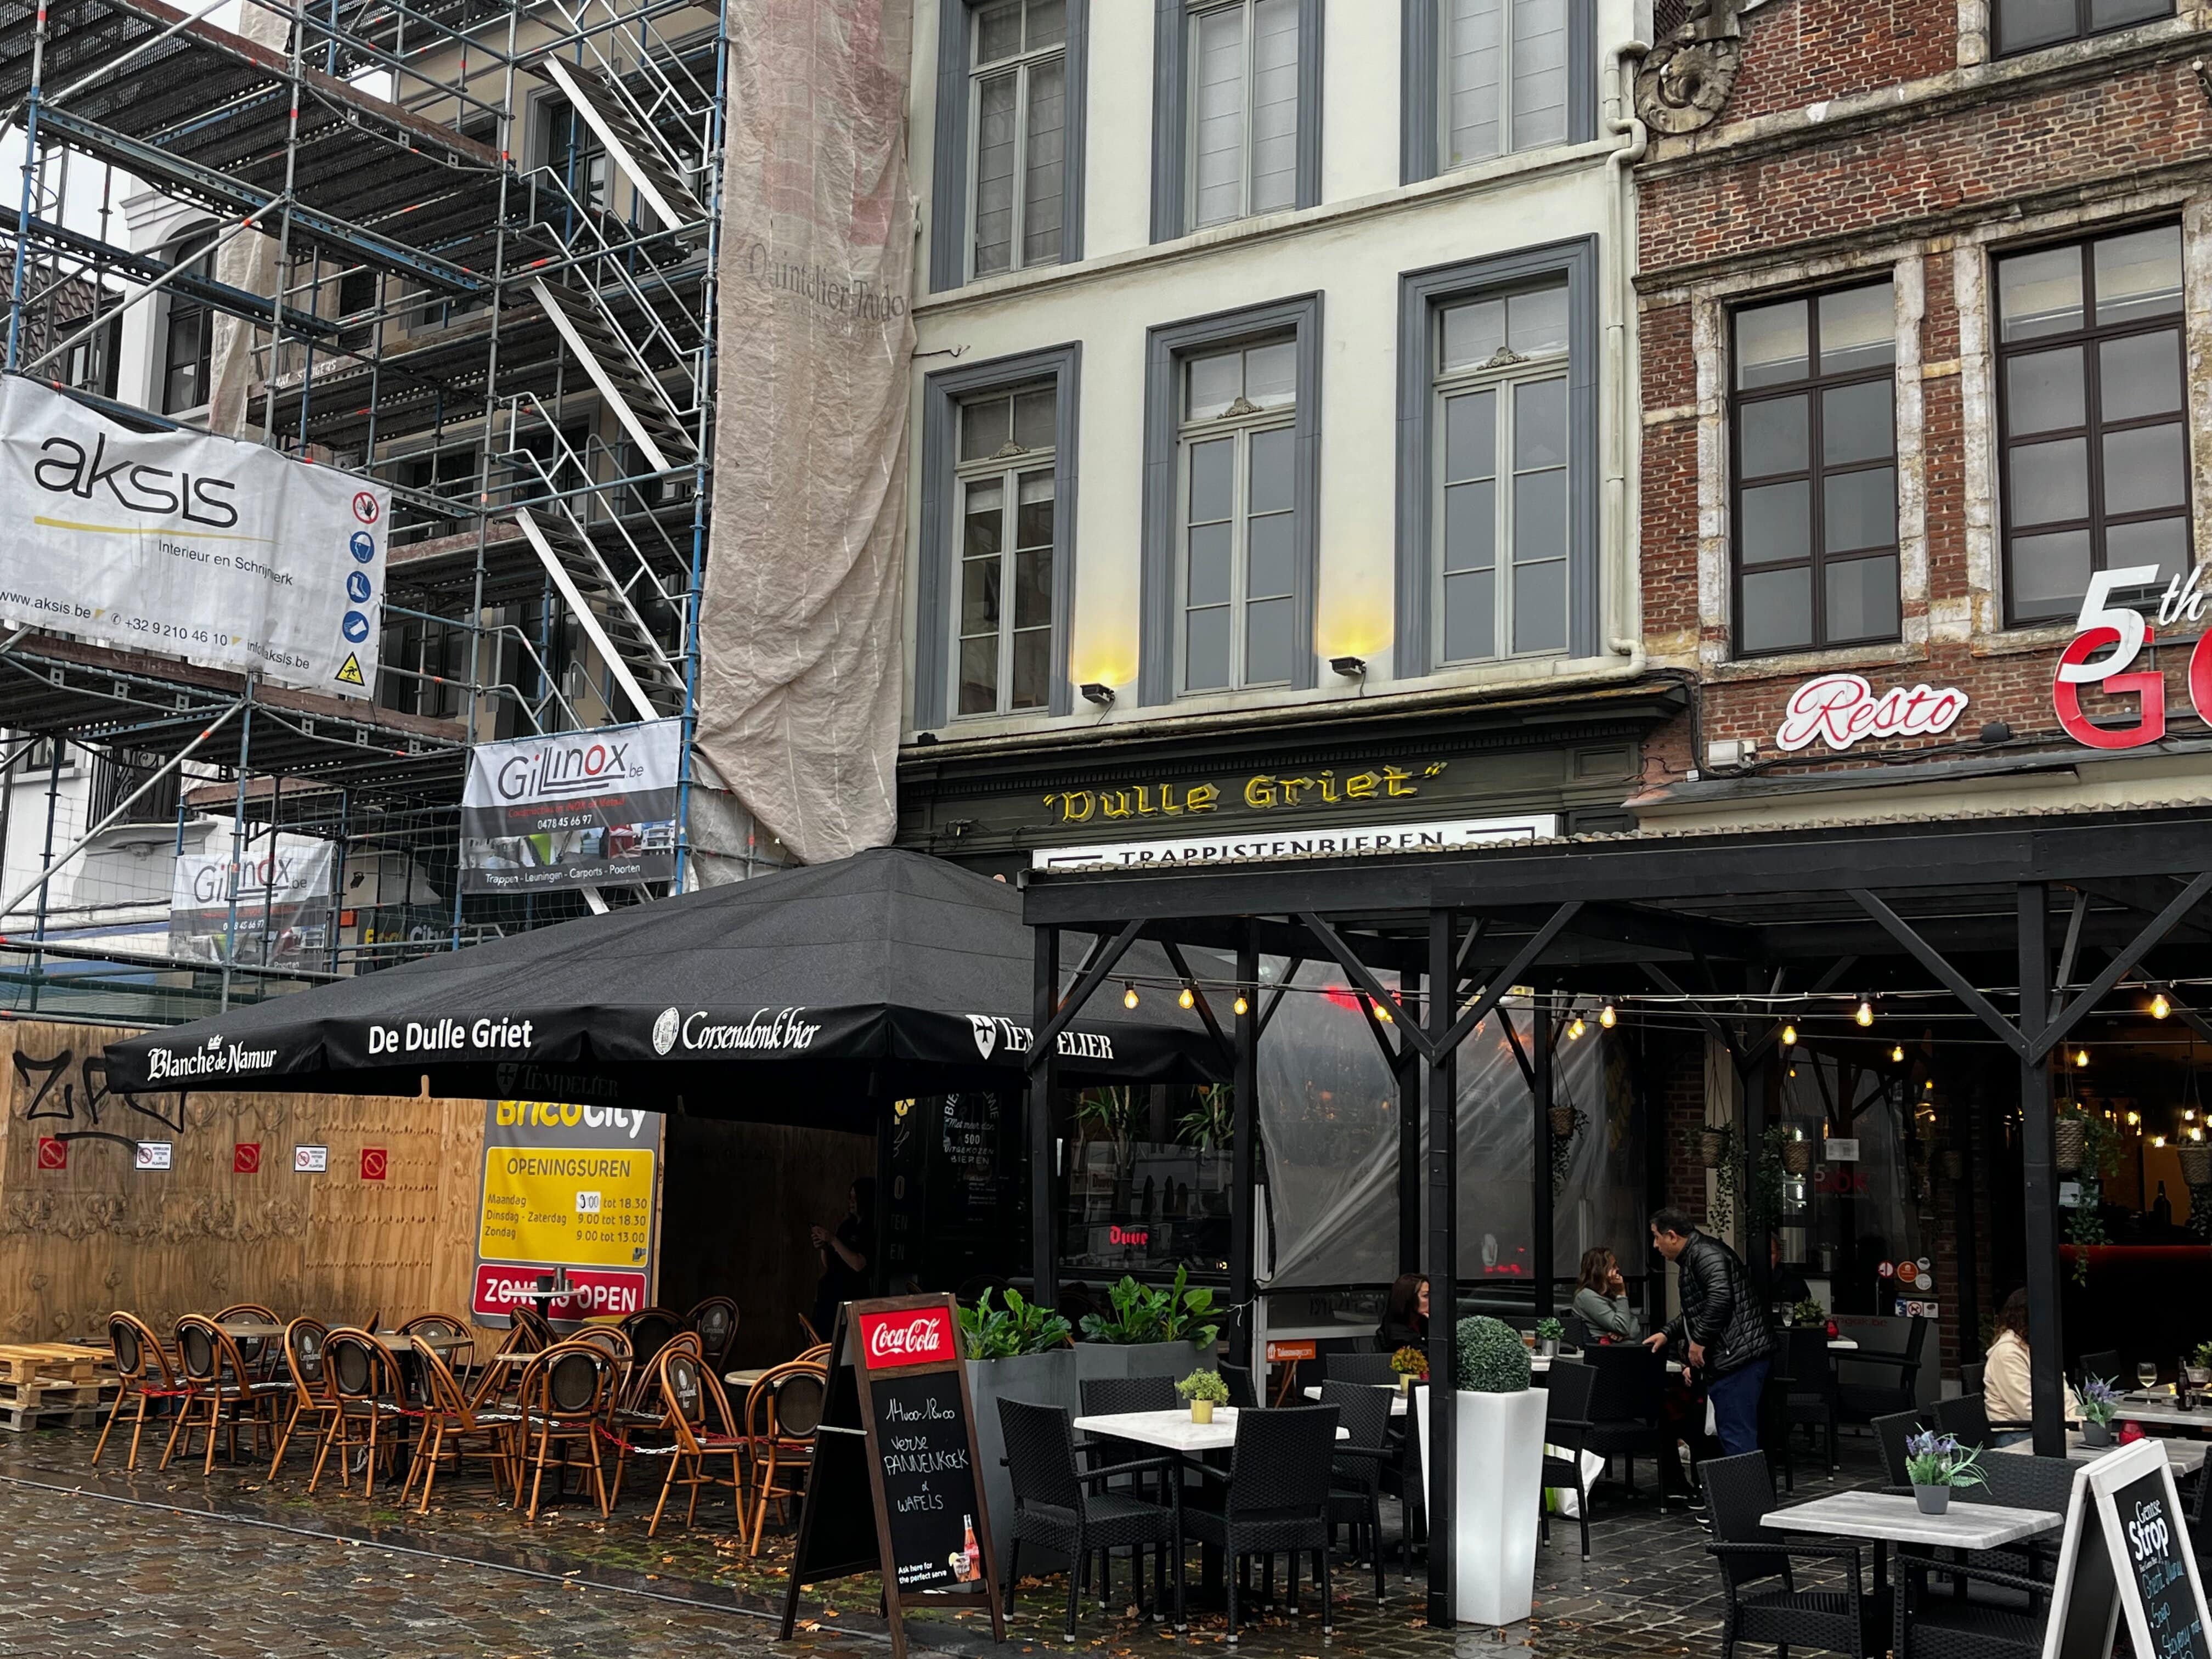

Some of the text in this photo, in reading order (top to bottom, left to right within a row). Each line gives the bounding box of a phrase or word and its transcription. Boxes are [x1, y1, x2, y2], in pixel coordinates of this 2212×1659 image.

[34, 432, 239, 528] aksis
[158, 539, 294, 586] Interieur en Schrijnerk
[0, 590, 92, 620] www.aksis.be
[125, 618, 228, 647] +32 9 210 46 10
[246, 637, 310, 670] infoaksis.be
[1781, 677, 1963, 746] Resto
[537, 814, 592, 830] 0478 45 66 97
[485, 873, 518, 887] Trappen
[525, 871, 562, 883] Leuningen
[569, 866, 602, 878] Carports
[610, 864, 640, 875] Poorten
[368, 1017, 533, 1054] De Dulle Griet
[682, 1006, 821, 1052] Corsendonk bier
[146, 1041, 277, 1082] Blanche de Namur
[964, 1133, 980, 1145] 500
[507, 1157, 631, 1178] OPENINGSUREN
[487, 1193, 527, 1208] Maandag
[603, 1198, 616, 1208] tot
[619, 1198, 647, 1210] 18.30
[486, 1211, 519, 1224] Dinsdag
[528, 1212, 567, 1226] Zaterdag
[578, 1214, 600, 1224] 9.00
[602, 1215, 616, 1225] tot
[619, 1215, 646, 1227] 18.30
[485, 1226, 645, 1244] Zondag 9.00 tot 13.00
[484, 1278, 637, 1312] ZONG OPEN
[871, 1317, 941, 1357] Coca-Cola
[884, 1448, 969, 1476] PANNENKOEK
[897, 1494, 944, 1513] WAFELS
[2129, 1517, 2169, 1561] Strop
[898, 1566, 910, 1575] Ask
[910, 1564, 923, 1572] here
[910, 1571, 932, 1584] perfect
[932, 1570, 947, 1578] serve
